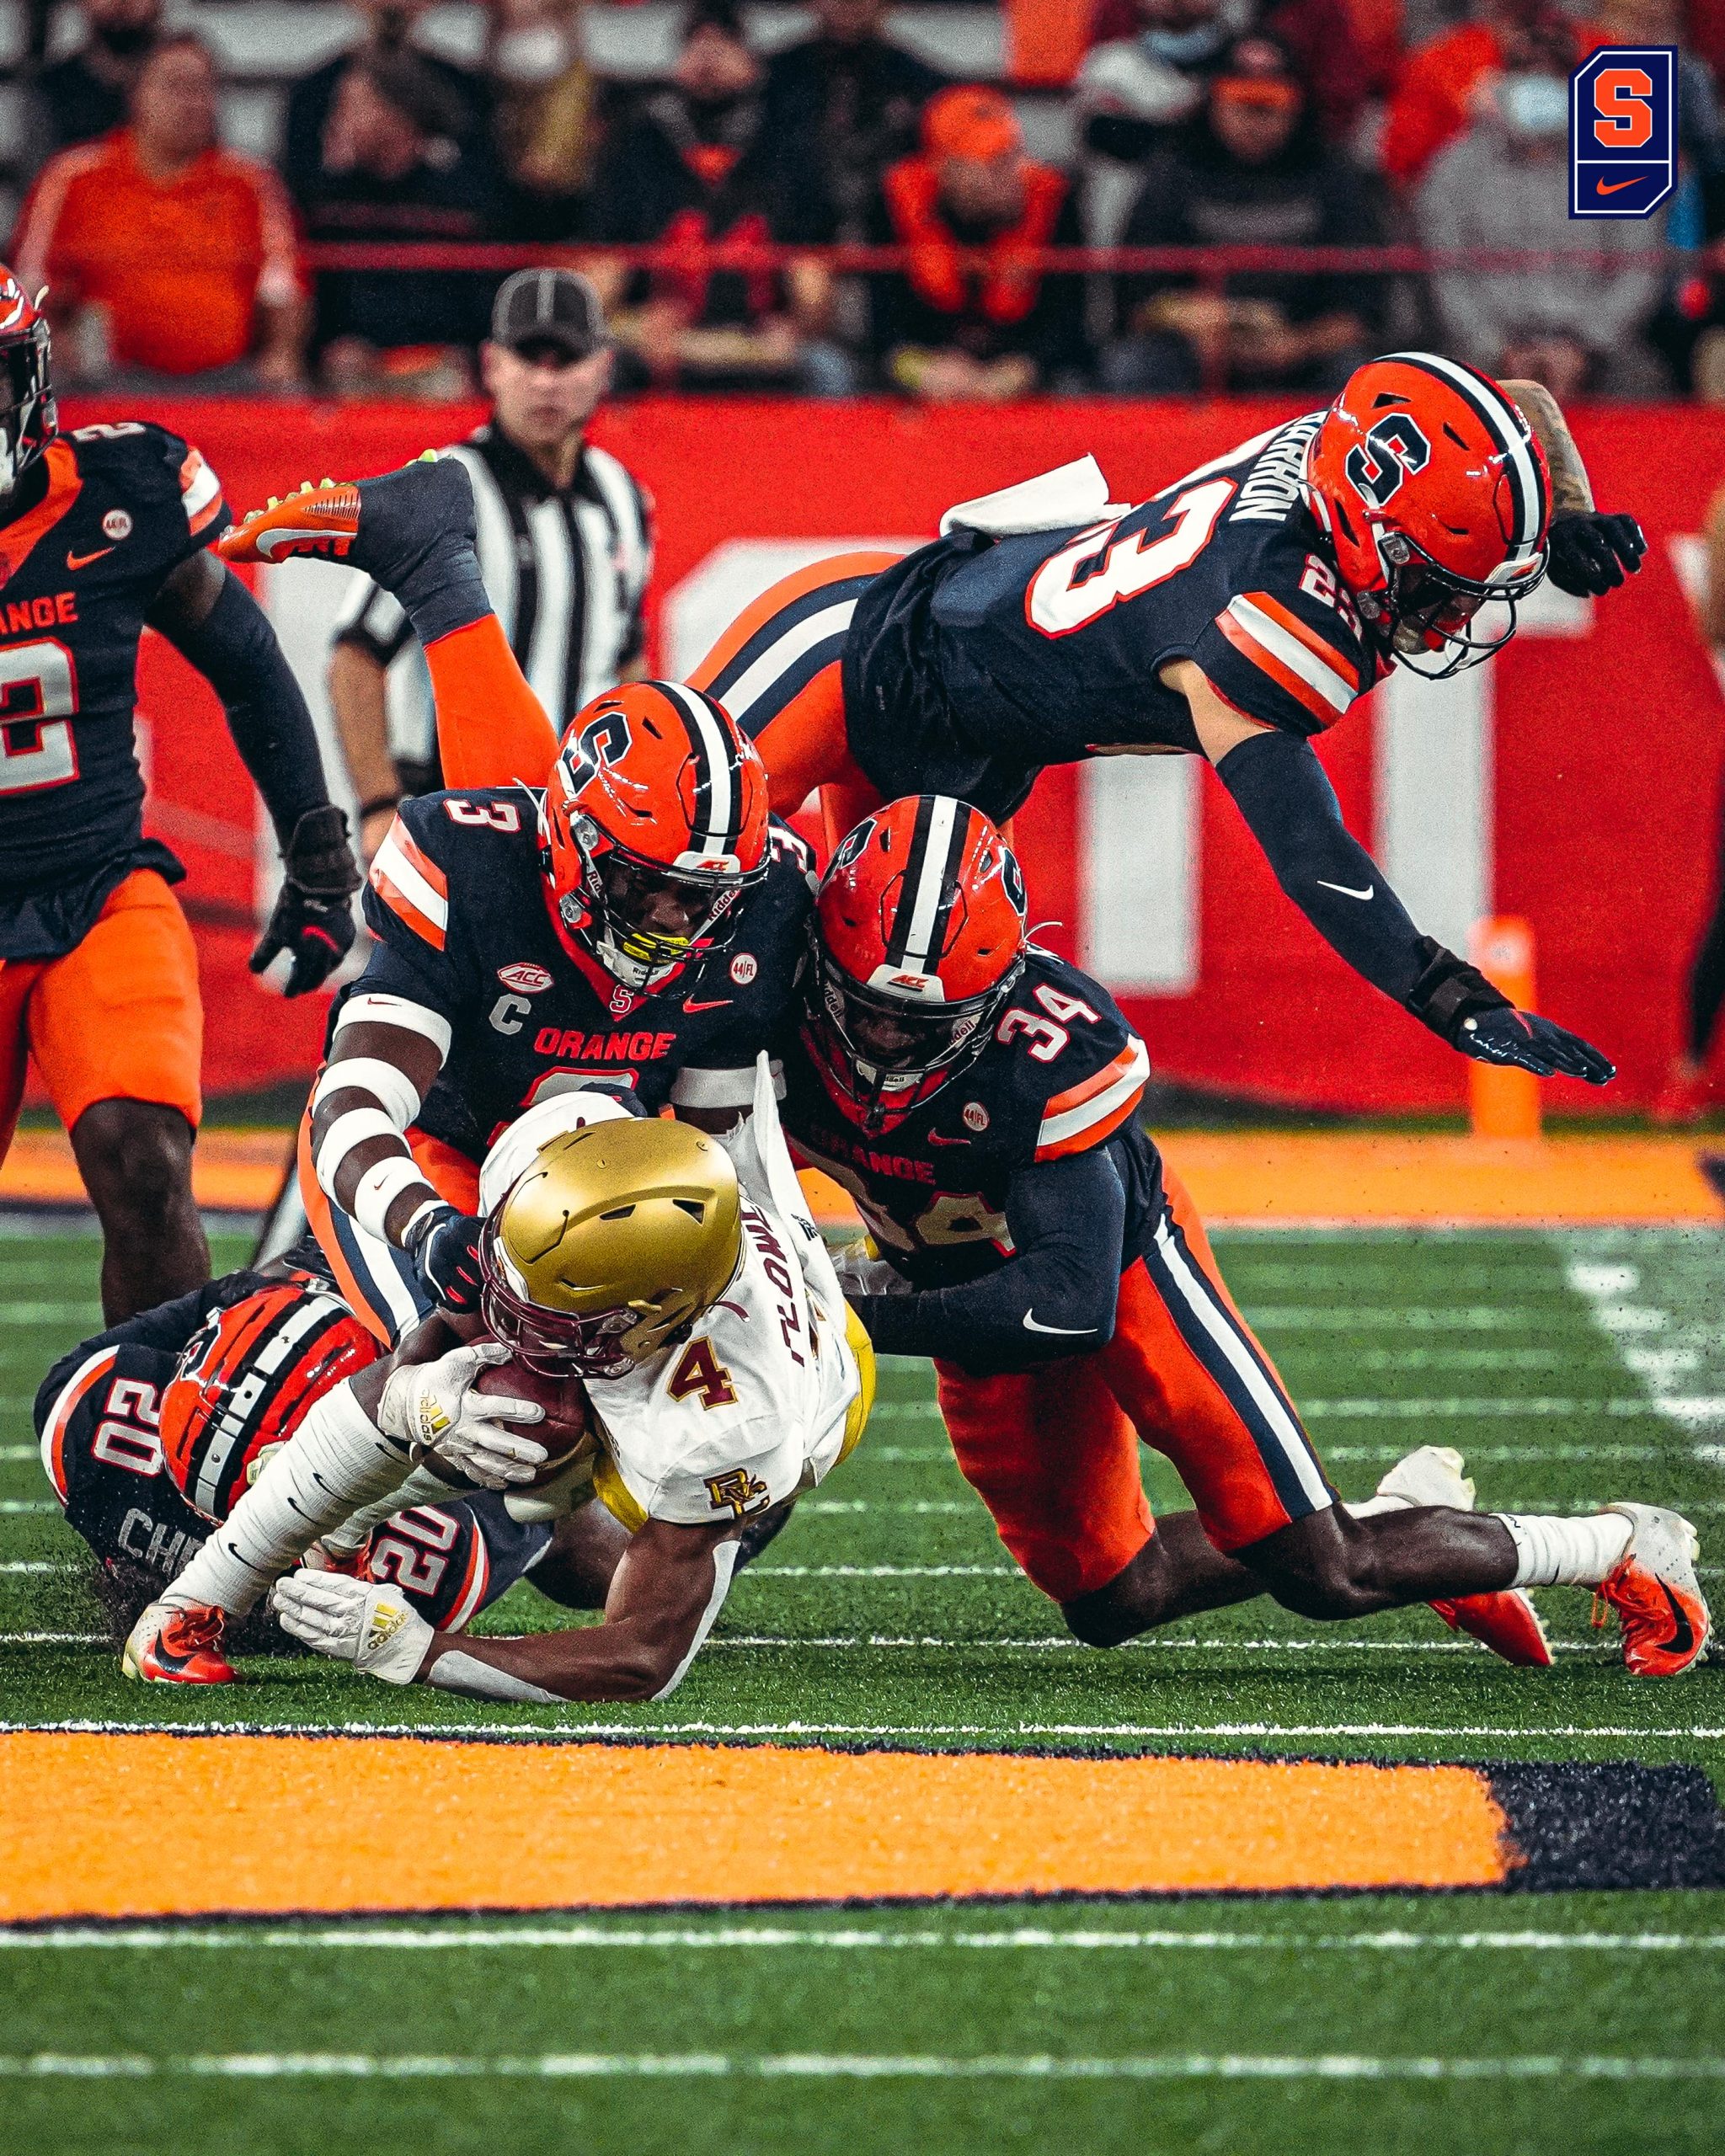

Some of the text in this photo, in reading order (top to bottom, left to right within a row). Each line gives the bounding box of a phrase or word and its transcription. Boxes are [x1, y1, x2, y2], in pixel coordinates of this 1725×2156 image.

[1229, 410, 1328, 521] BARRON
[1345, 412, 1431, 508] S
[0, 591, 79, 633] NGE
[559, 710, 633, 799] S
[443, 798, 521, 834] 3
[708, 889, 737, 921] Ridde
[506, 969, 547, 988] ACC
[608, 985, 633, 1013] S
[887, 974, 929, 992] ACC
[489, 994, 531, 1035] C
[995, 982, 1103, 1062] 34
[533, 1027, 676, 1061] ORANGE
[666, 1336, 739, 1411] 4
[91, 1376, 166, 1478] 20
[371, 1504, 461, 1598] 20
